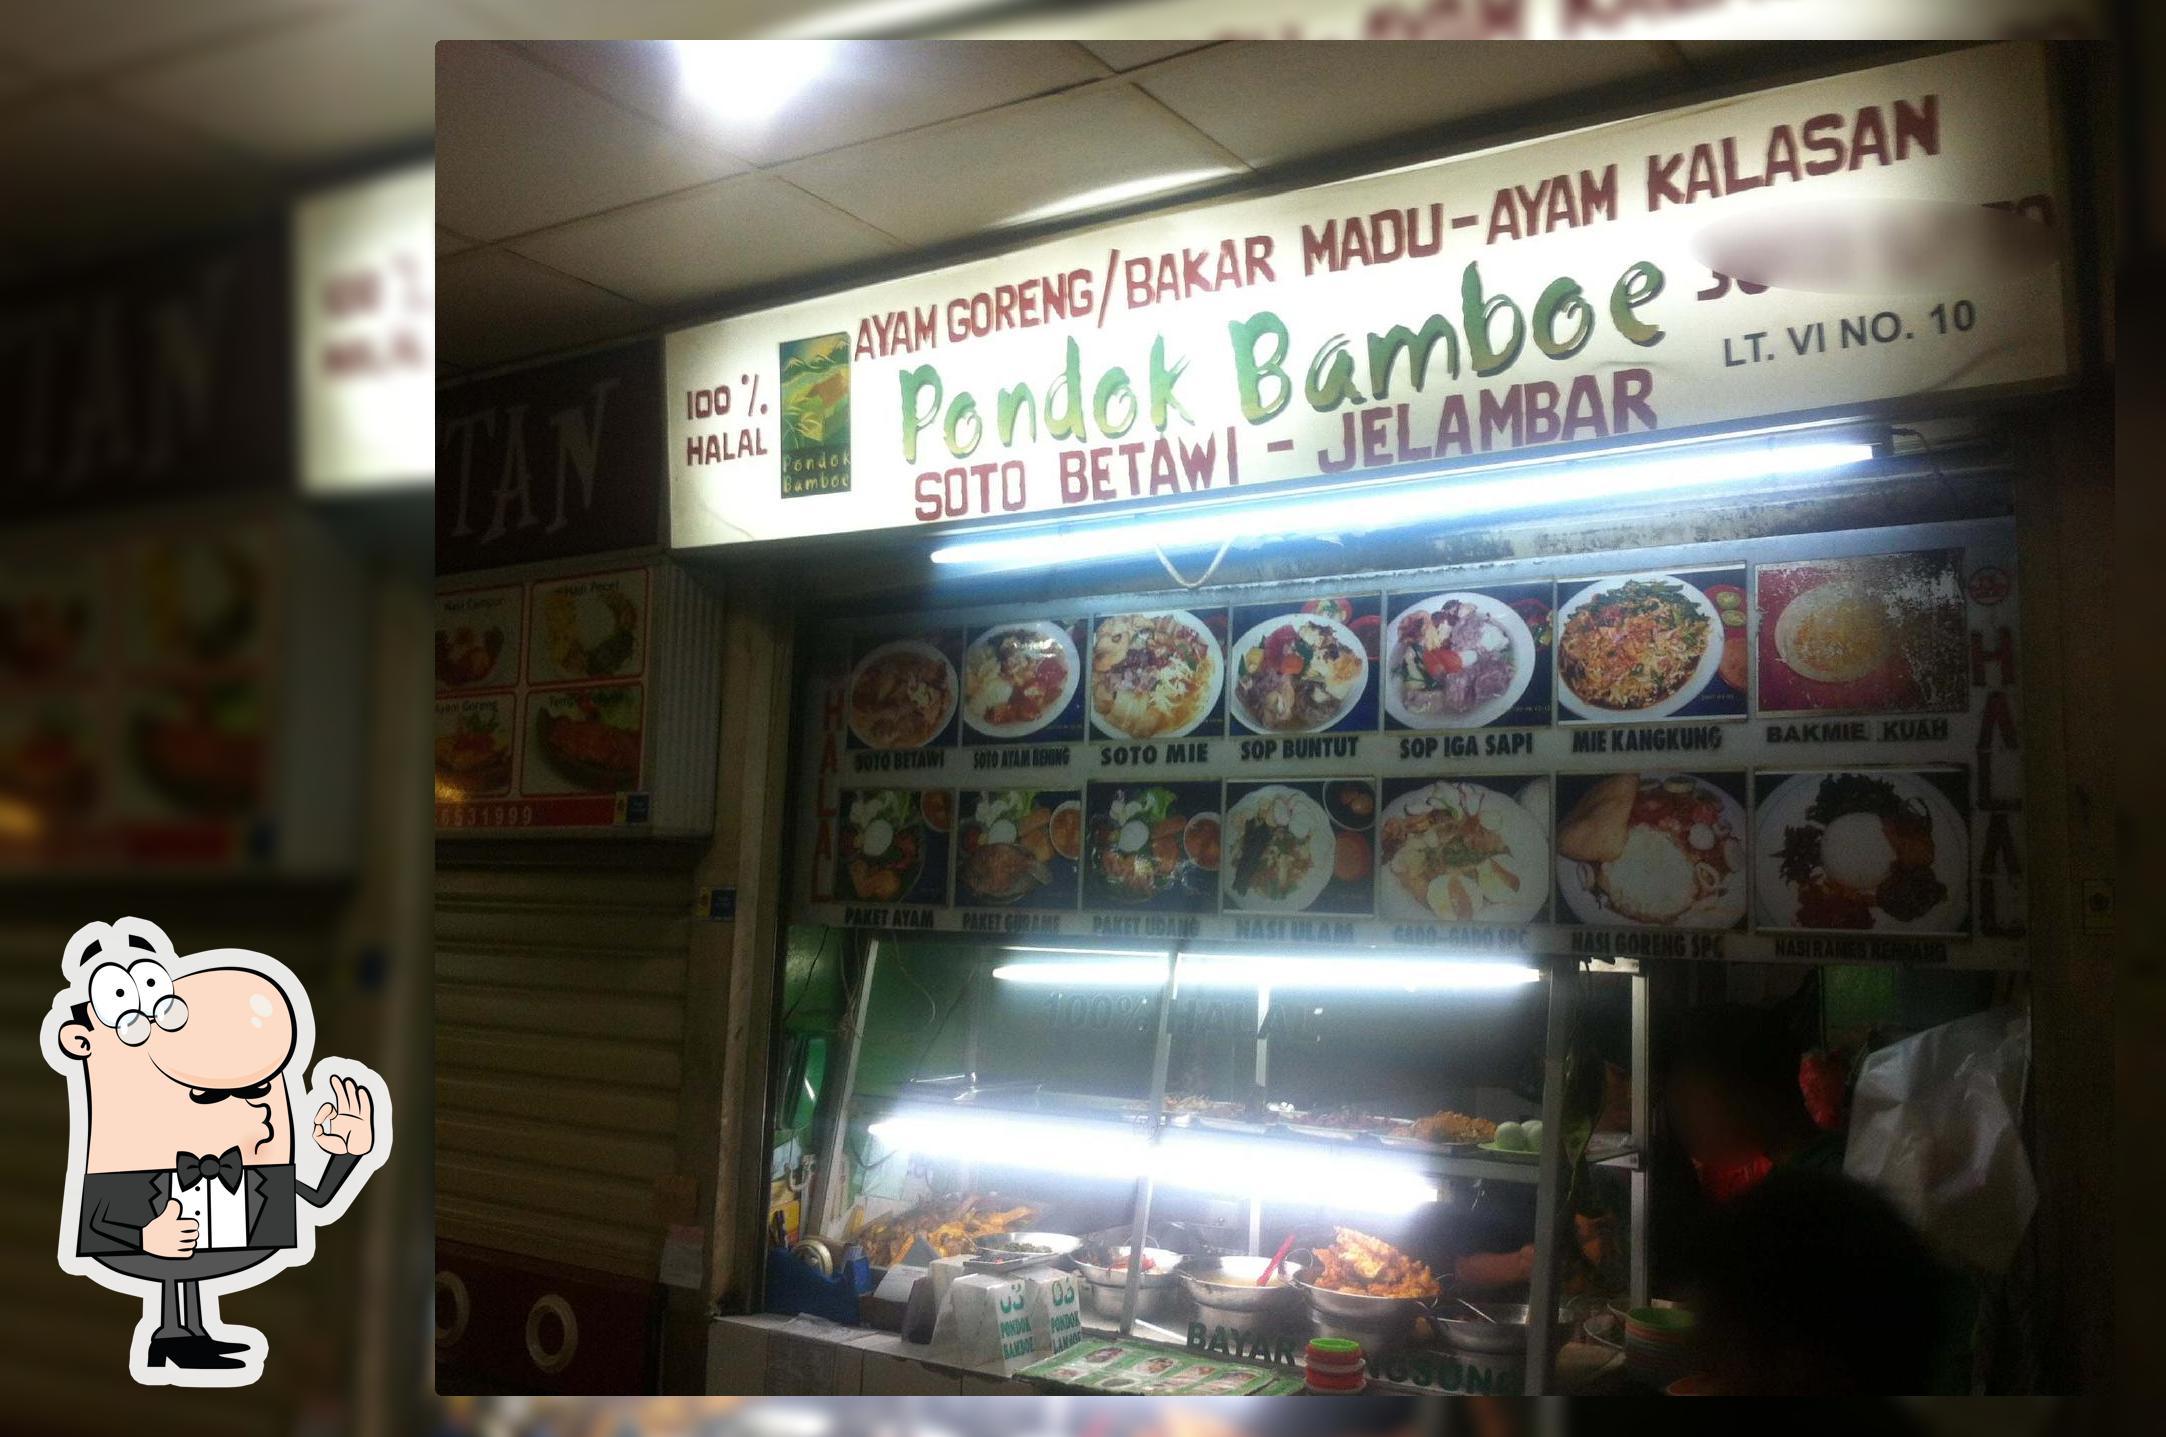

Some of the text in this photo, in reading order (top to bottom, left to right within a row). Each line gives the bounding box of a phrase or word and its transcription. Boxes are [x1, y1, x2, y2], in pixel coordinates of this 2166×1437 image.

[854, 305, 937, 361] AYAM
[1646, 96, 1940, 204] KALASAN
[1724, 299, 1976, 367] LT. VI NO. 10
[899, 260, 1667, 464] Pondok Bamboe
[686, 428, 768, 467] HALAL
[914, 460, 1027, 522] SOTO
[1060, 427, 1240, 503] BETAWI
[1318, 367, 1659, 474] JELAMBAR
[782, 450, 851, 473] Pondok
[1400, 732, 1534, 759] SOP IGA SAPI
[1572, 725, 1722, 753] MIE KANGKUNG
[1766, 720, 1949, 744] BAKMIE KUAH
[1100, 742, 1209, 766] SOTO MIE
[1240, 735, 1359, 761] SOP BUNTUT
[845, 908, 935, 929] PAKET AYAM
[1616, 933, 1685, 957] GORENG
[1187, 1322, 1297, 1367] BAYAR
